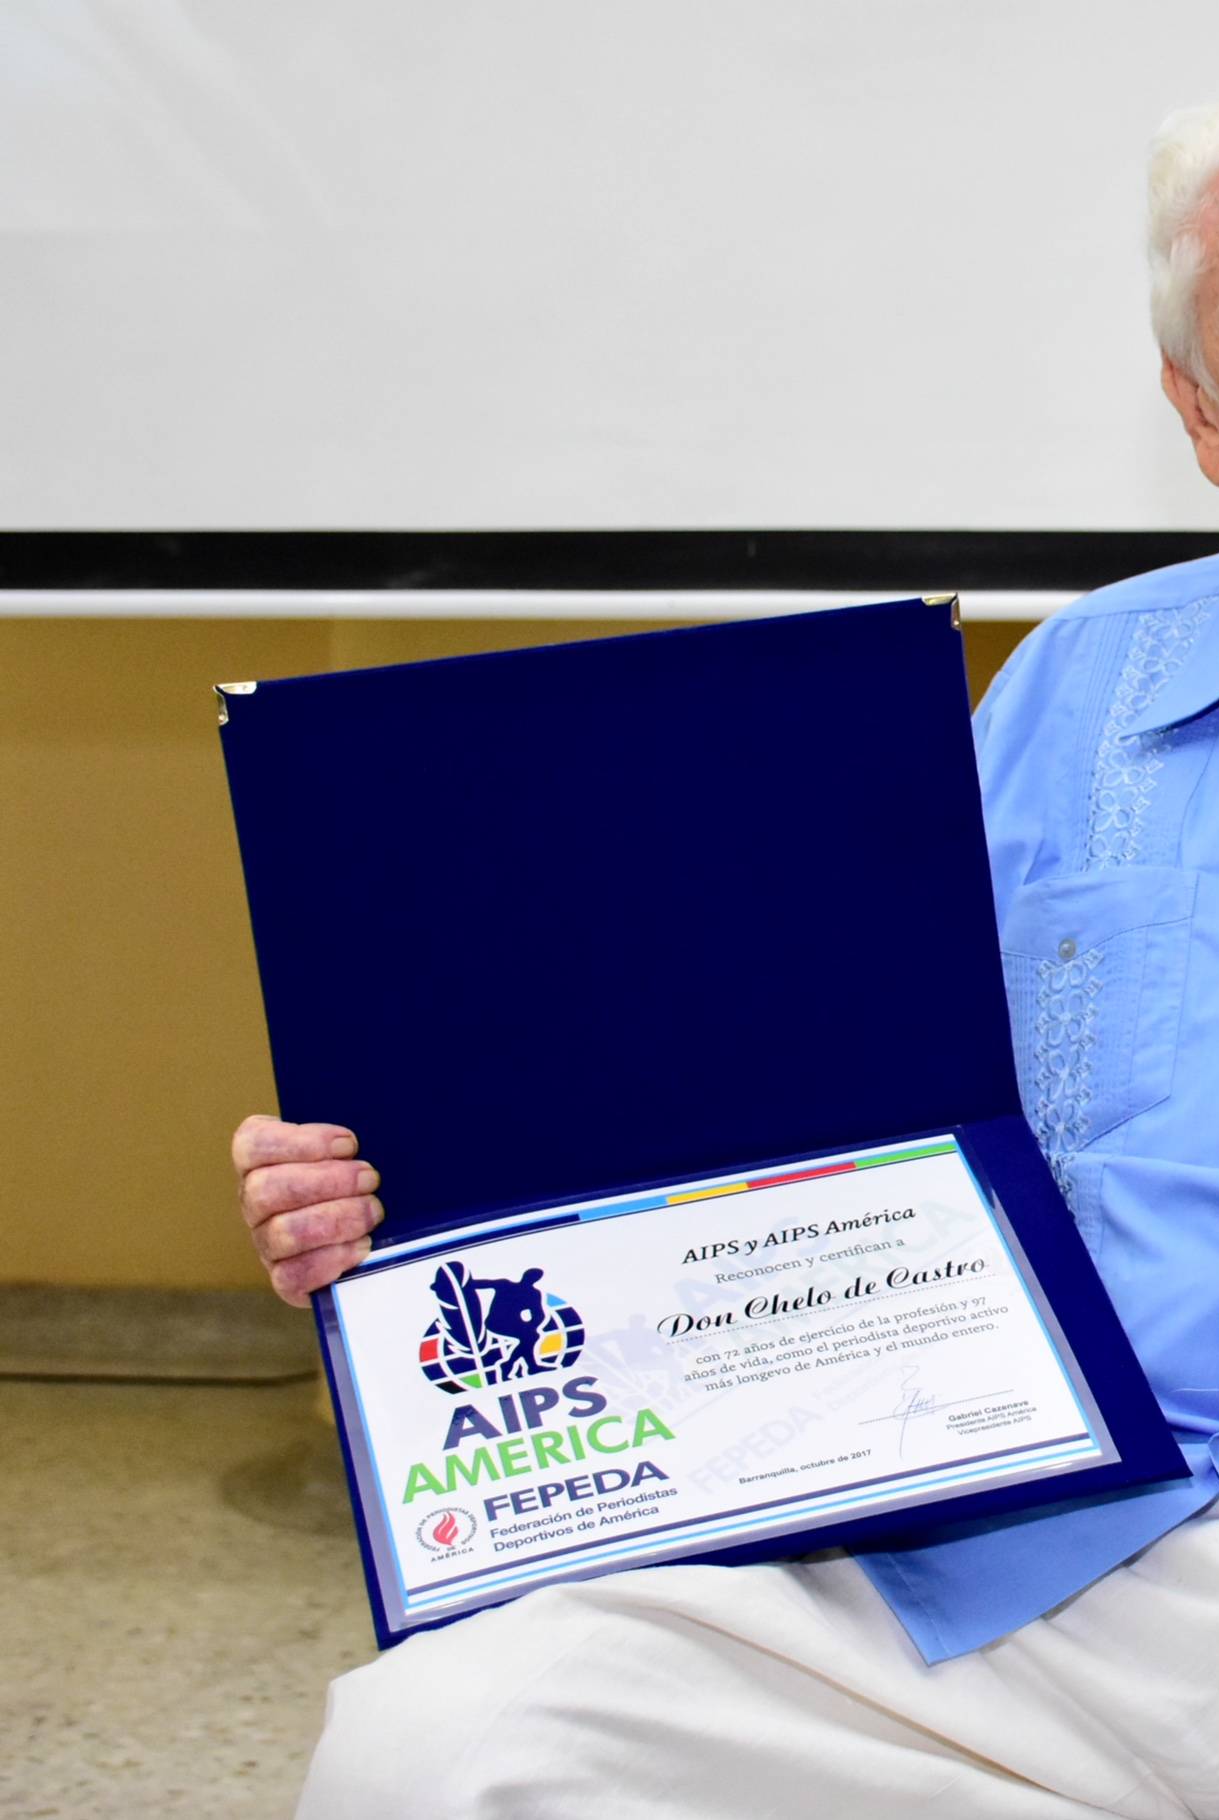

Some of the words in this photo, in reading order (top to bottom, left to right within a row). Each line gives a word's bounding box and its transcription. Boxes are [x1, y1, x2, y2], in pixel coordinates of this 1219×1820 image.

[682, 1239, 740, 1264] AIPS
[744, 1239, 758, 1256] y
[763, 1223, 820, 1248] AIPS
[824, 1208, 916, 1235] América
[714, 1259, 802, 1284] Reconocen
[804, 1256, 814, 1268] y
[819, 1241, 892, 1262] certifican
[895, 1239, 905, 1247] a
[656, 1310, 738, 1338] Don
[743, 1288, 833, 1319] Chelo
[843, 1275, 878, 1300] de
[885, 1257, 989, 1289] Castro
[683, 1368, 717, 1382] años
[719, 1362, 736, 1374] de
[739, 1356, 774, 1369] vida,
[775, 1347, 813, 1362] como
[816, 1341, 829, 1353] el
[831, 1329, 900, 1352] periodista
[902, 1315, 967, 1334] deportivo
[970, 1306, 1009, 1320] activo
[695, 1353, 721, 1365] con
[723, 1349, 741, 1360] 72
[743, 1341, 776, 1355] años
[778, 1335, 795, 1347] de
[798, 1323, 855, 1344] ejercicio
[858, 1319, 874, 1329] de
[876, 1315, 891, 1325] la
[893, 1302, 957, 1324] profesión
[959, 1300, 968, 1310] y
[971, 1296, 986, 1306] 97
[704, 1378, 734, 1392] más
[735, 1366, 791, 1385] longevo
[794, 1361, 811, 1372] de
[815, 1349, 871, 1368] América
[873, 1346, 881, 1357] y
[885, 1340, 898, 1352] el
[900, 1331, 949, 1349] mundo
[951, 1323, 999, 1338] entero.
[444, 1376, 607, 1450] AIPS
[402, 1408, 677, 1505] AMERICA
[738, 1467, 798, 1485] Barranquilla,
[799, 1458, 836, 1471] octubre
[850, 1448, 871, 1460] 2017
[483, 1460, 669, 1522] FEPEDA
[489, 1512, 572, 1539] Federación
[575, 1507, 594, 1517] de
[596, 1488, 678, 1512] Periodistas
[493, 1526, 574, 1552] Deportivos
[576, 1520, 595, 1531] de
[599, 1506, 659, 1526] América
